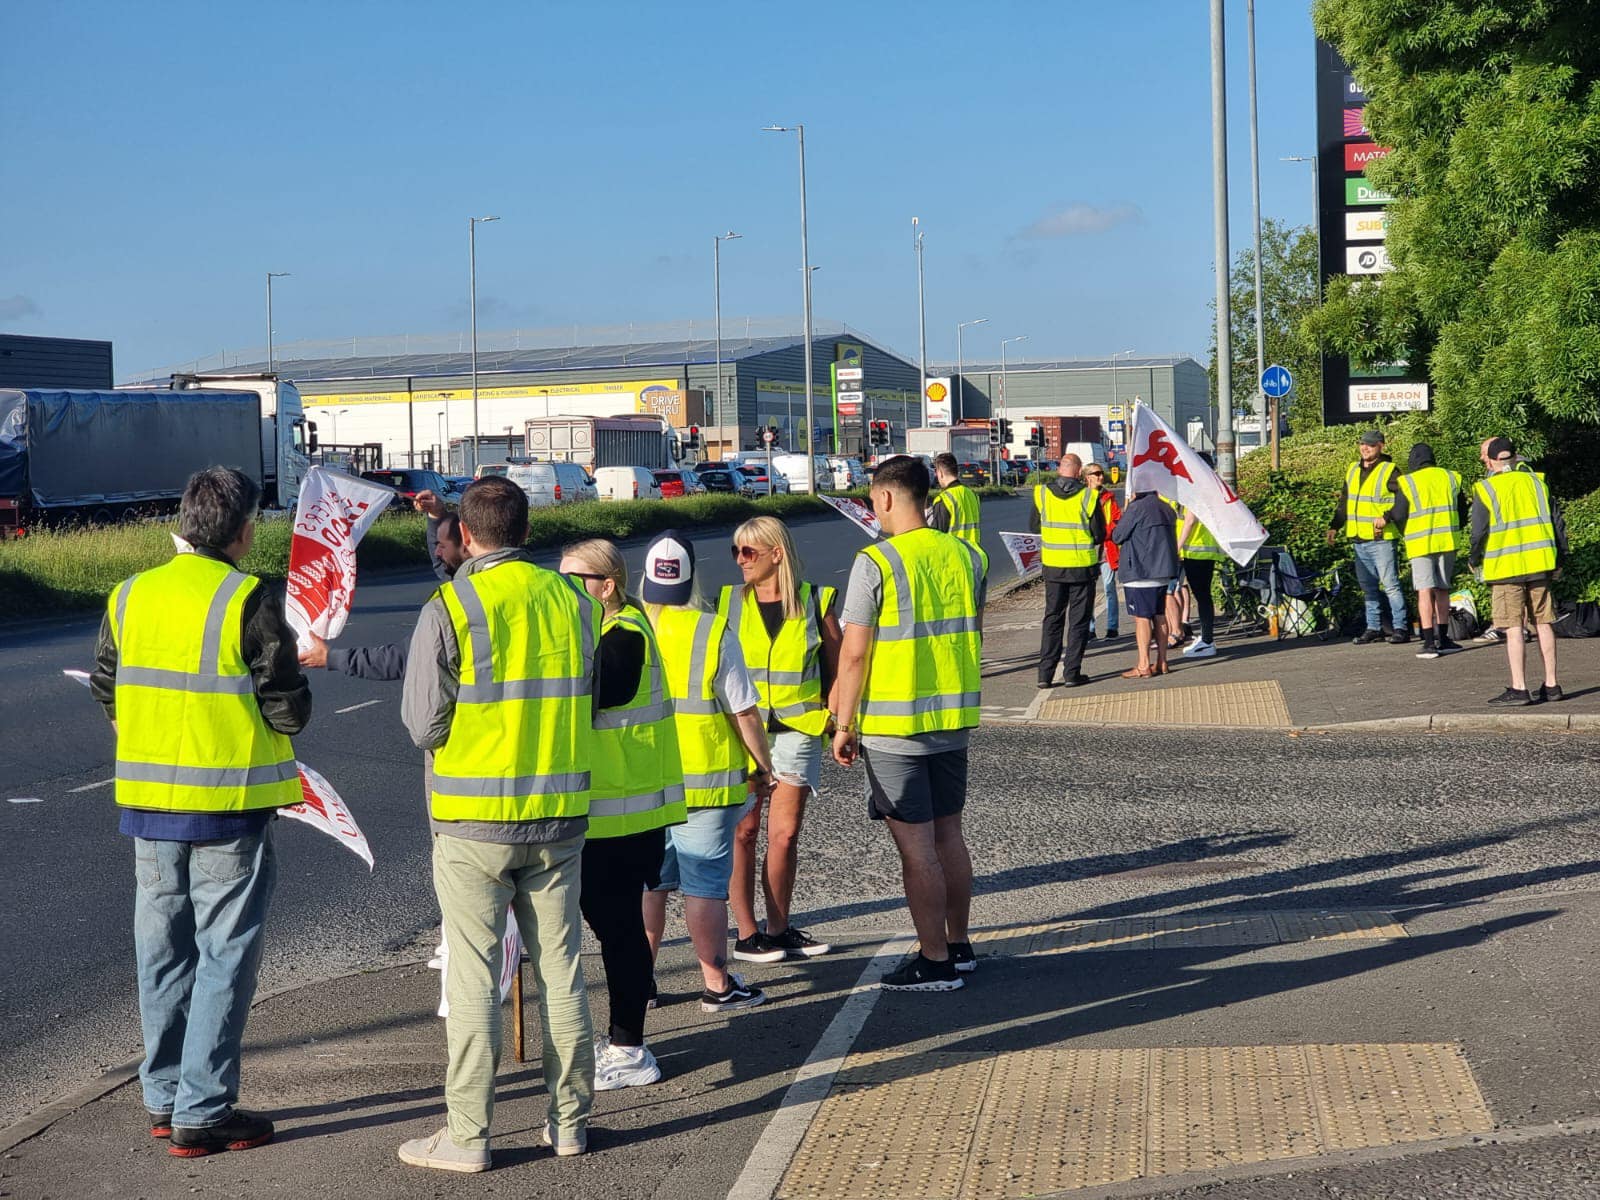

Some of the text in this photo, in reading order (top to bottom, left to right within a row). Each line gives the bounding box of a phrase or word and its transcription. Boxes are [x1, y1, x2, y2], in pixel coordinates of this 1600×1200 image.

[650, 395, 681, 406] DRIVE
[1357, 391, 1421, 401] LEE BARON
[652, 404, 680, 415] THRU
